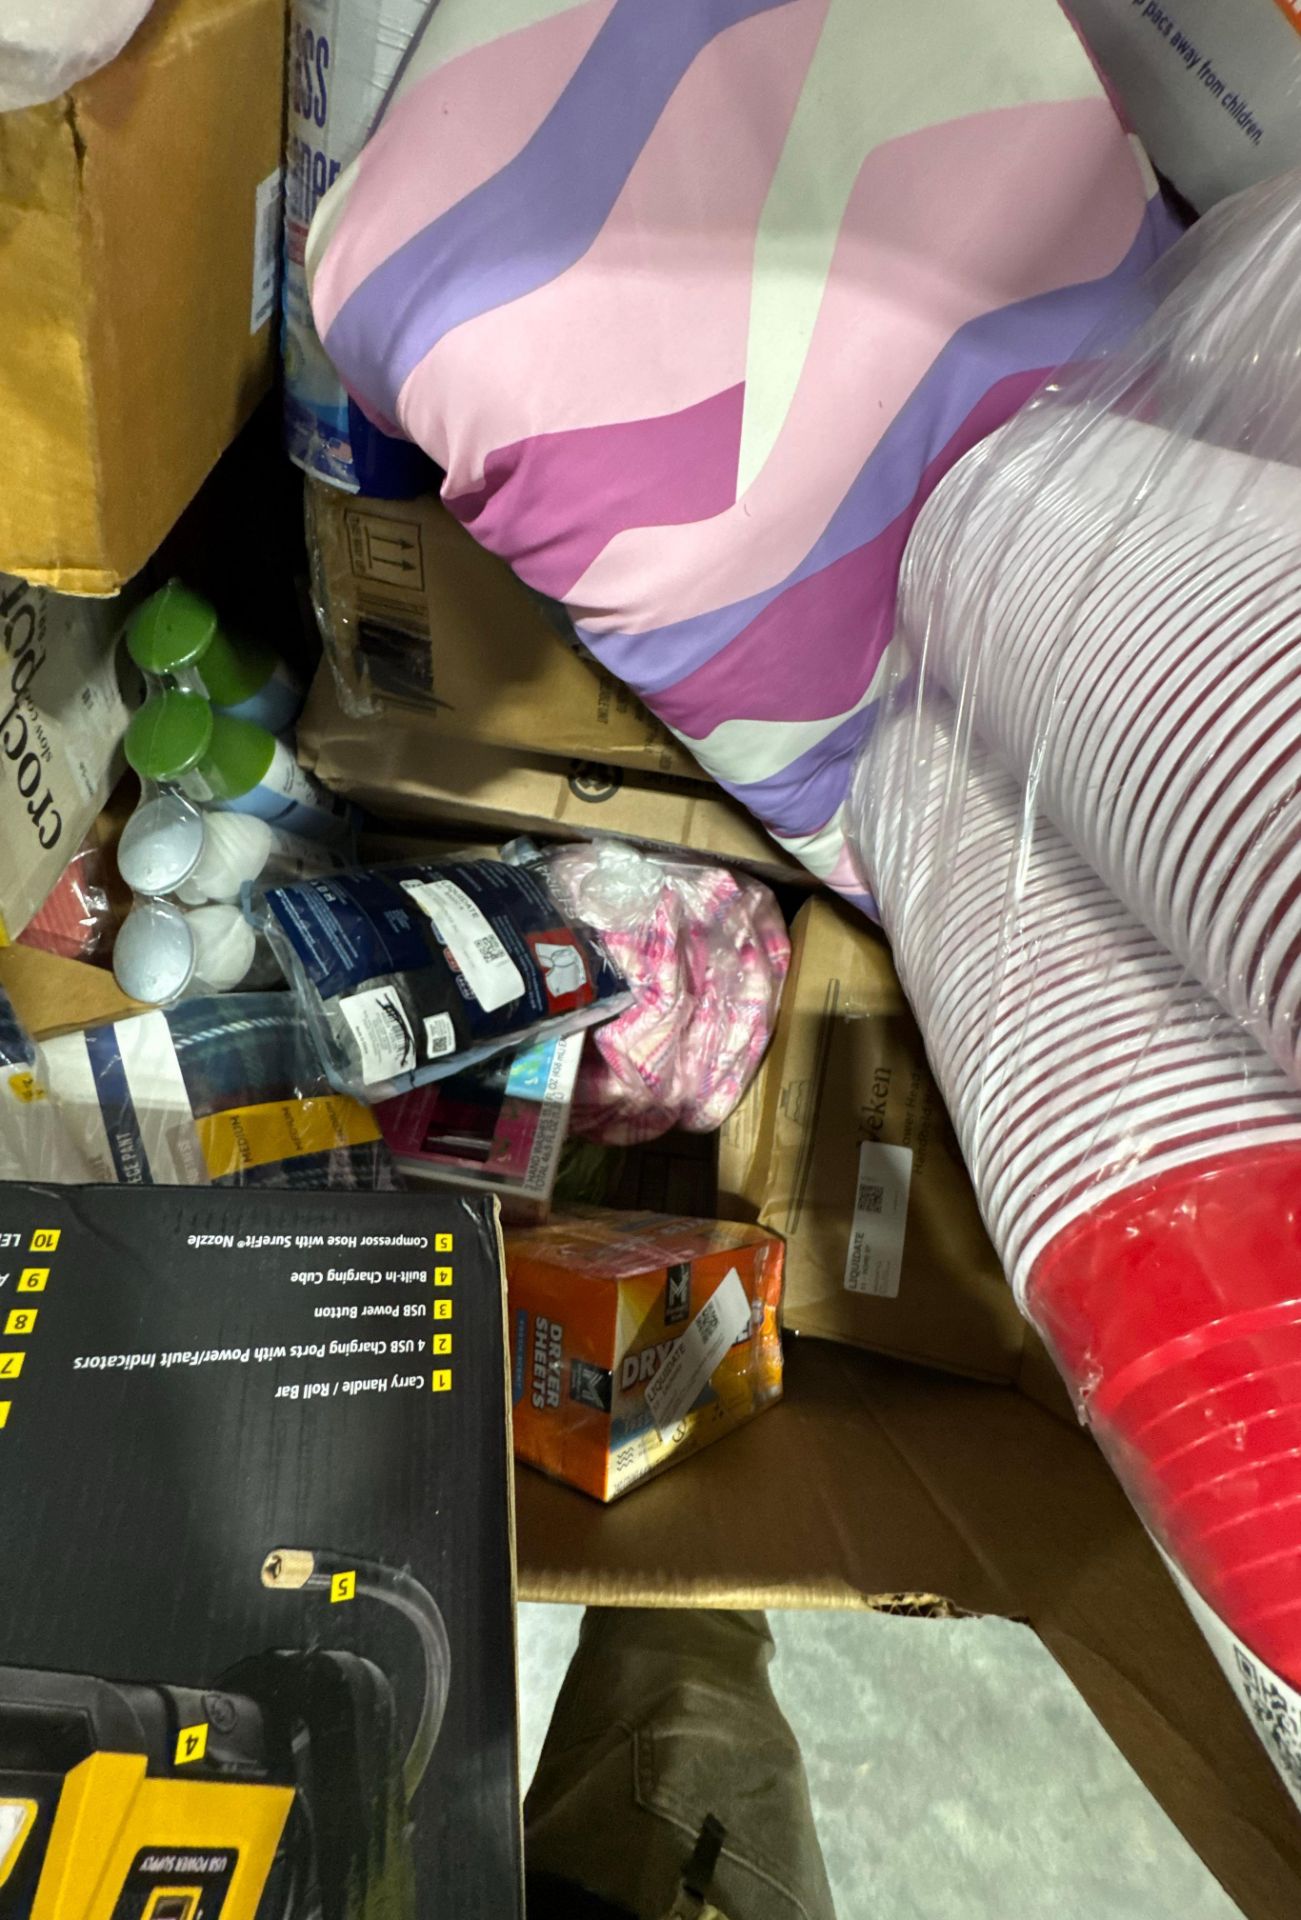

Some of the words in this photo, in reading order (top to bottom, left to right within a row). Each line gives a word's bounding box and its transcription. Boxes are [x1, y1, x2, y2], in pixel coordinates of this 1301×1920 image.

[1142, 2, 1173, 37] pacs
[1169, 31, 1201, 70] away
[1197, 59, 1226, 98] from
[1221, 92, 1263, 146] children.
[230, 1114, 254, 1164] MEDIUM
[115, 1133, 138, 1165] PANT
[527, 1156, 540, 1183] HAND
[0, 1233, 21, 1247] LE
[34, 1234, 53, 1248] 10
[187, 1234, 234, 1249] Nozzle
[295, 1235, 324, 1248] with
[327, 1235, 357, 1248] Hose
[360, 1234, 428, 1248] Compressor
[440, 1237, 448, 1249] 5
[27, 1273, 40, 1287] 9
[290, 1271, 324, 1285] Cube
[327, 1268, 382, 1285] Charging
[385, 1270, 428, 1283] Built-In
[439, 1271, 448, 1282] 4
[314, 1306, 358, 1319] Button
[361, 1305, 399, 1317] Power
[403, 1304, 426, 1317] USB
[439, 1303, 447, 1316] 3
[15, 1314, 28, 1330] 8
[289, 1343, 326, 1358] Ports
[329, 1339, 387, 1356] Charging
[390, 1339, 414, 1352] USB
[417, 1339, 426, 1351] 4
[438, 1338, 447, 1351] 2
[72, 1352, 156, 1371] Indicators
[160, 1347, 250, 1368] Power/Fault
[254, 1346, 286, 1363] with
[1, 1357, 14, 1374] 7
[532, 1316, 549, 1409] SHEETS
[546, 1323, 562, 1409] DRYER
[342, 1378, 388, 1395] Handle
[391, 1373, 425, 1389] Carry
[274, 1384, 299, 1399] Bar
[303, 1382, 330, 1399] Roll
[333, 1381, 339, 1397] /
[338, 1577, 350, 1596] 5
[184, 1734, 199, 1754] 4
[139, 1857, 176, 1872] SUPPLY
[175, 1857, 210, 1872] POWER
